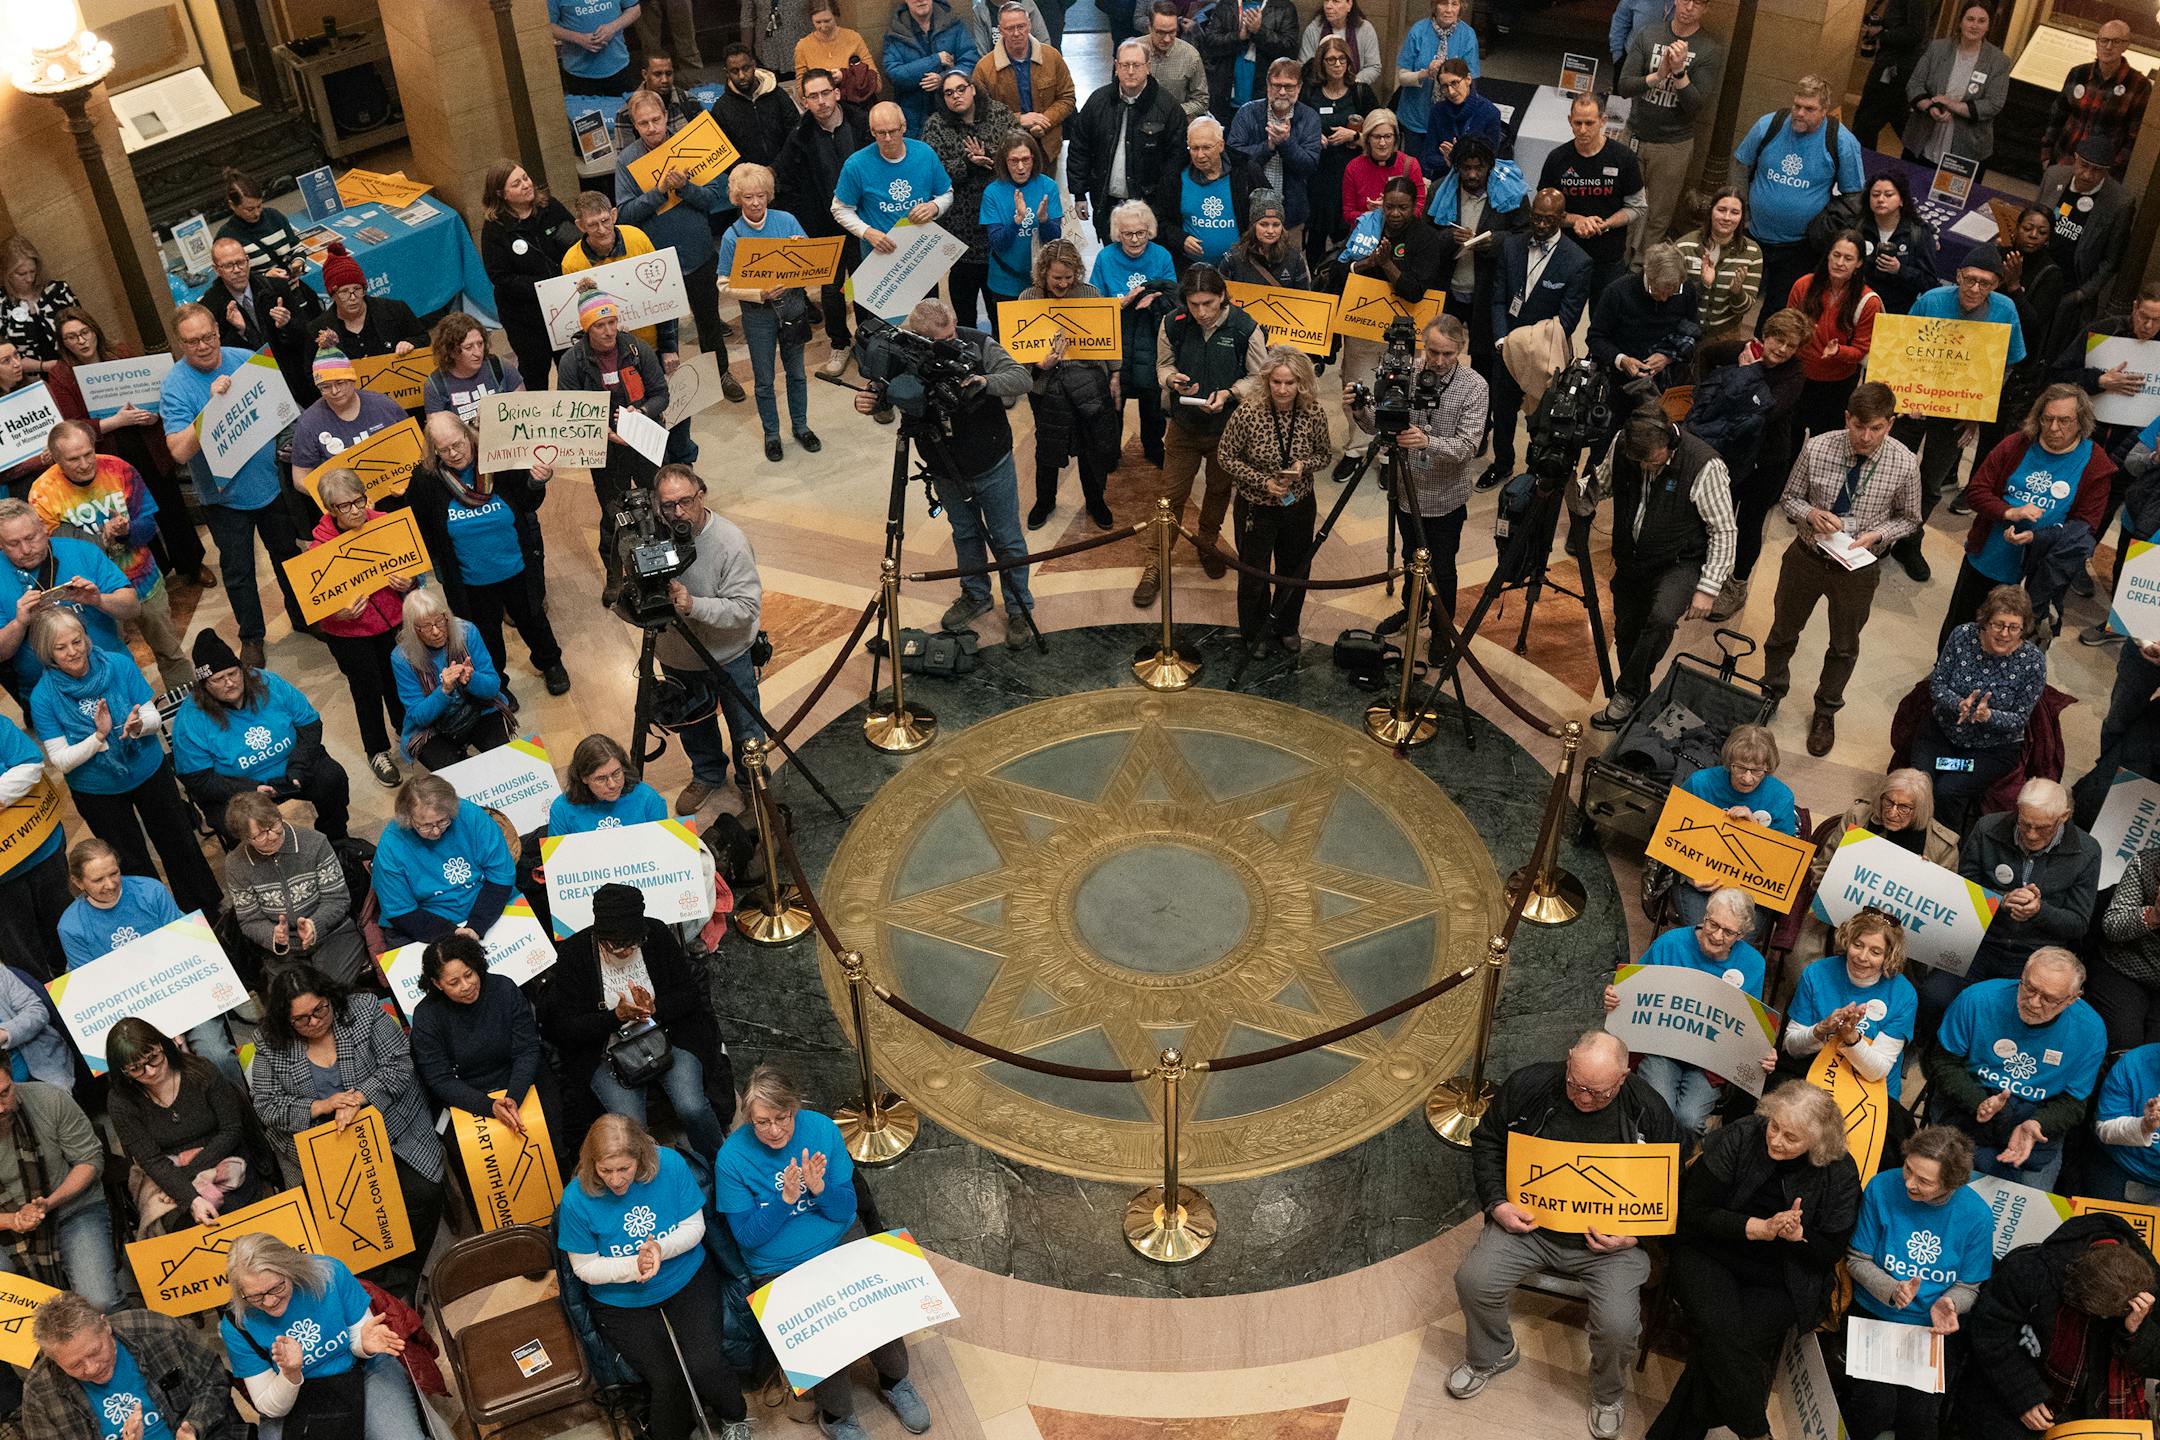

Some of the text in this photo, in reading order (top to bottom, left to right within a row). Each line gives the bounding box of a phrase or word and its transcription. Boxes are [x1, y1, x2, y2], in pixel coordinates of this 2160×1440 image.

[575, 0, 612, 16] Beacon
[1643, 89, 1679, 108] USTICE
[686, 144, 728, 180] WITH HOME
[1560, 178, 1601, 186] HOUSING
[1767, 168, 1810, 189] Beacon
[879, 198, 924, 213] Beacon
[1191, 216, 1234, 228] Beacon
[2059, 216, 2083, 234] Sma
[741, 267, 830, 279] START WITH HOME
[866, 234, 931, 304] SUPPORTIVE HOUSING.
[874, 234, 944, 310] ENDING HOMELESSNESS.
[643, 299, 678, 319] Home
[1344, 314, 1376, 328] EMPIEZA
[1012, 338, 1046, 350] START
[1080, 338, 1112, 346] HOME
[1260, 324, 1324, 342] WITH HOME
[1906, 346, 1971, 361] CENTRAL
[86, 367, 151, 385] everyone
[394, 386, 420, 399] WITH
[1916, 384, 1984, 400] Supportive
[211, 381, 266, 442] WE BELIEVE
[570, 402, 608, 418] HOME
[1902, 398, 1952, 413] Services
[5, 405, 52, 434] Habitat
[11, 417, 55, 441] for Humanity
[22, 431, 48, 445] Minnesota
[217, 441, 228, 458] IN
[560, 448, 574, 456] HAS
[578, 448, 584, 456] A
[581, 456, 604, 466] HOME
[366, 478, 379, 490] ON
[380, 474, 389, 482] EL
[66, 491, 129, 528] LOVE
[2008, 485, 2056, 510] Beacon
[448, 502, 502, 521] Beacon
[312, 551, 417, 606] START WITH HOME
[2130, 576, 2160, 592] BUIL
[238, 736, 292, 770] Beacon
[485, 780, 552, 810] MELESSNESS.
[491, 771, 539, 797] HOUSING.
[2138, 798, 2157, 816] IN
[0, 790, 56, 854] ART WITH HOME
[556, 860, 660, 886] BUILDING HOMES.
[1664, 836, 1786, 894] START WITH HOME
[1844, 884, 1865, 906] IN
[1854, 864, 1958, 927] WE BELIEVE
[680, 910, 702, 918] Beacon
[487, 933, 536, 968] MMUNITY.
[603, 960, 645, 978] AINT PAU
[74, 954, 206, 1024] SUPPORTIVE HOUSING.
[80, 962, 224, 1038] ENDING HOMELESSNESS.
[1632, 1010, 1652, 1025] IN
[1636, 993, 1746, 1037] WE BELIEVE
[1824, 1052, 1844, 1087] TART
[1978, 1066, 2046, 1100] Beacon
[472, 1112, 514, 1229] START WITH HOME
[355, 1124, 394, 1250] EMPIEZA CON EL HOGAR
[1520, 1192, 1663, 1216] START WITH HOME
[1993, 1195, 2027, 1260] SUPPORTIV
[610, 1224, 678, 1258] Beaon
[1884, 1254, 1957, 1284] Beacon
[160, 1278, 209, 1302] START
[777, 1274, 888, 1336] BUILDING HOMES.
[785, 1276, 929, 1350] CREATING COMMUNITY.
[303, 1328, 350, 1369] acon
[1784, 1351, 1795, 1374] IN
